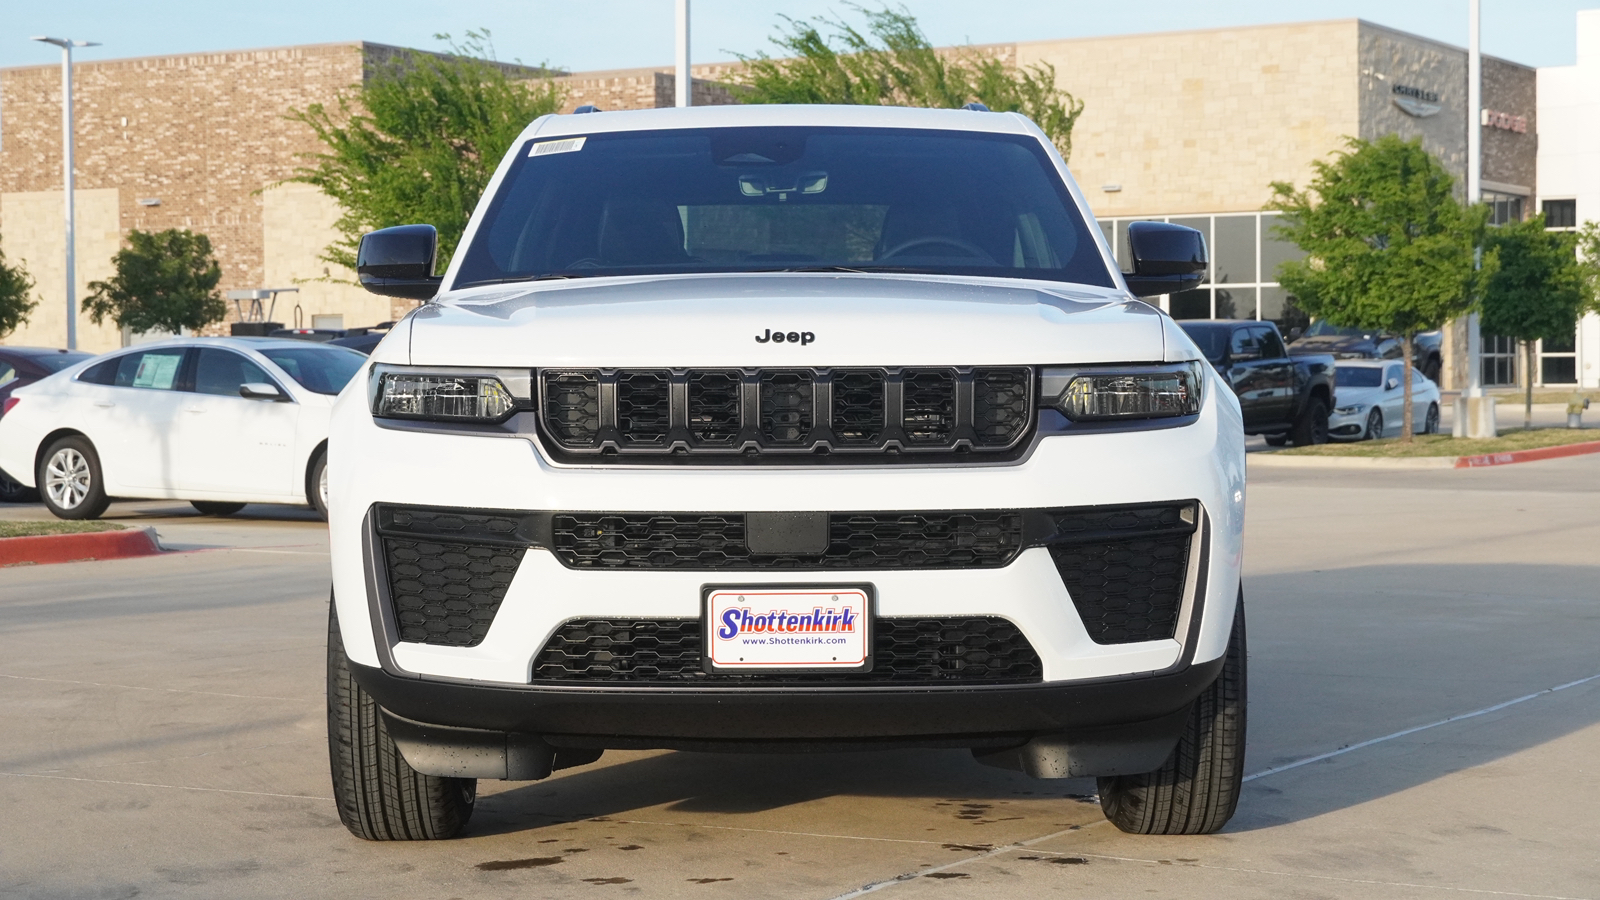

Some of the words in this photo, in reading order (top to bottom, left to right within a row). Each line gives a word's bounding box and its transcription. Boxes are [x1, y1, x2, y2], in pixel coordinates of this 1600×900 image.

[1481, 109, 1527, 133] DODGE
[755, 328, 815, 346] Jeep
[718, 607, 857, 640] Shottenkirk
[742, 637, 847, 645] www.Shottenkirk.com
